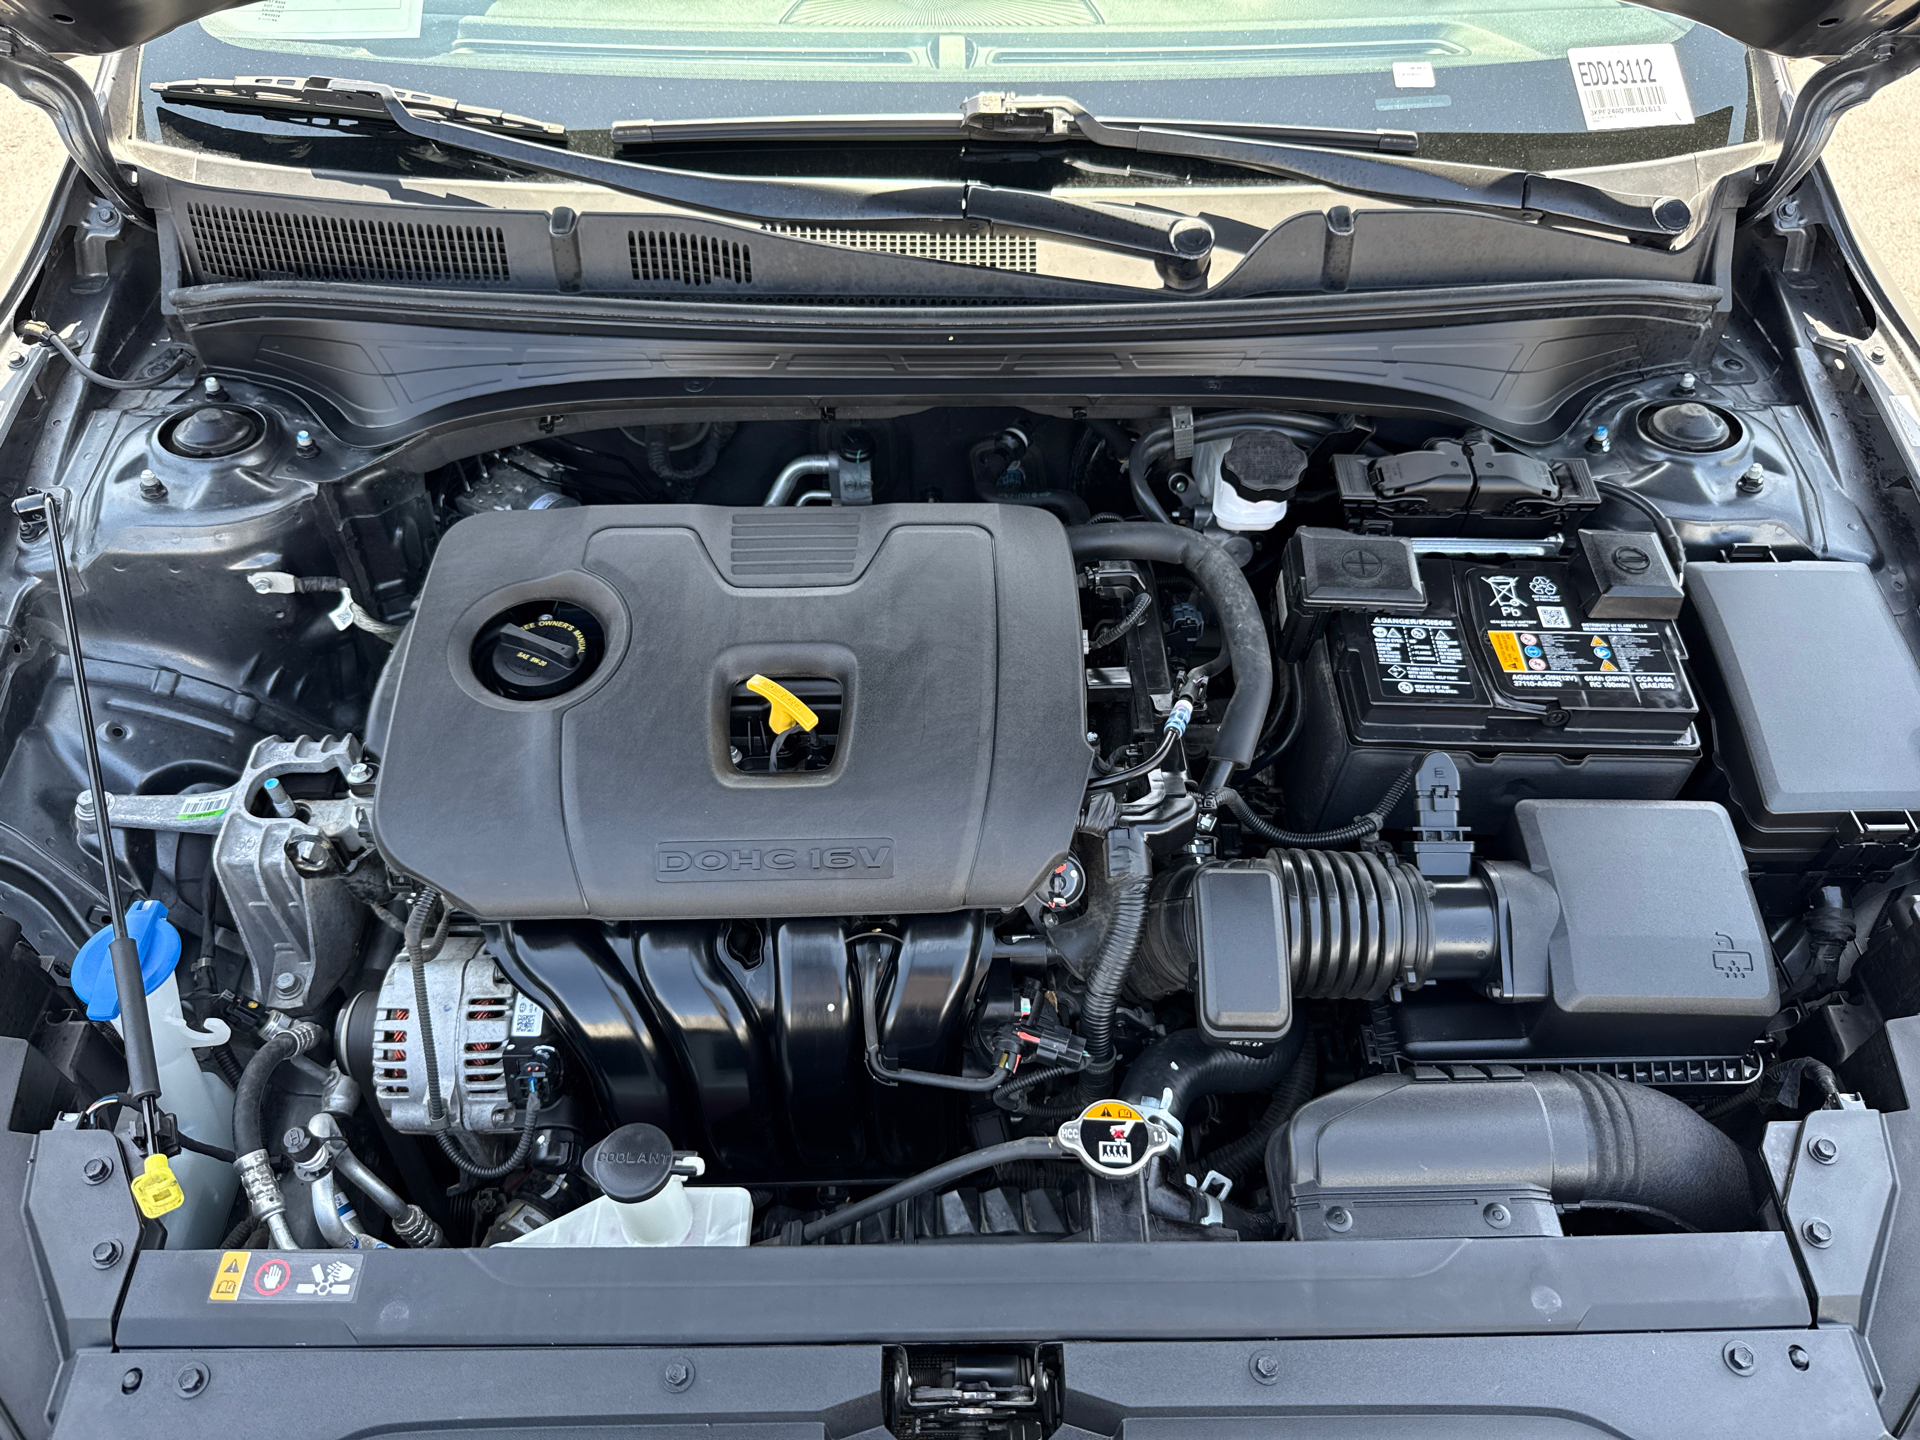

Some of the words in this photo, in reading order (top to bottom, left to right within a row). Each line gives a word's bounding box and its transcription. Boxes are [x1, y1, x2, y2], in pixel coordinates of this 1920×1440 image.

[1577, 58, 1657, 87] EDD13112
[1501, 606, 1521, 617] Pb
[1381, 618, 1453, 626] DANGER/POISON
[539, 621, 574, 631] OWNER'S
[573, 630, 586, 654] MANUAL
[517, 652, 530, 661] SAE
[658, 848, 798, 873] DOHC
[810, 846, 891, 871] 16V
[1061, 1128, 1079, 1139] HCC
[1153, 1131, 1166, 1142] 1.1
[597, 1150, 671, 1165] COOLANT
